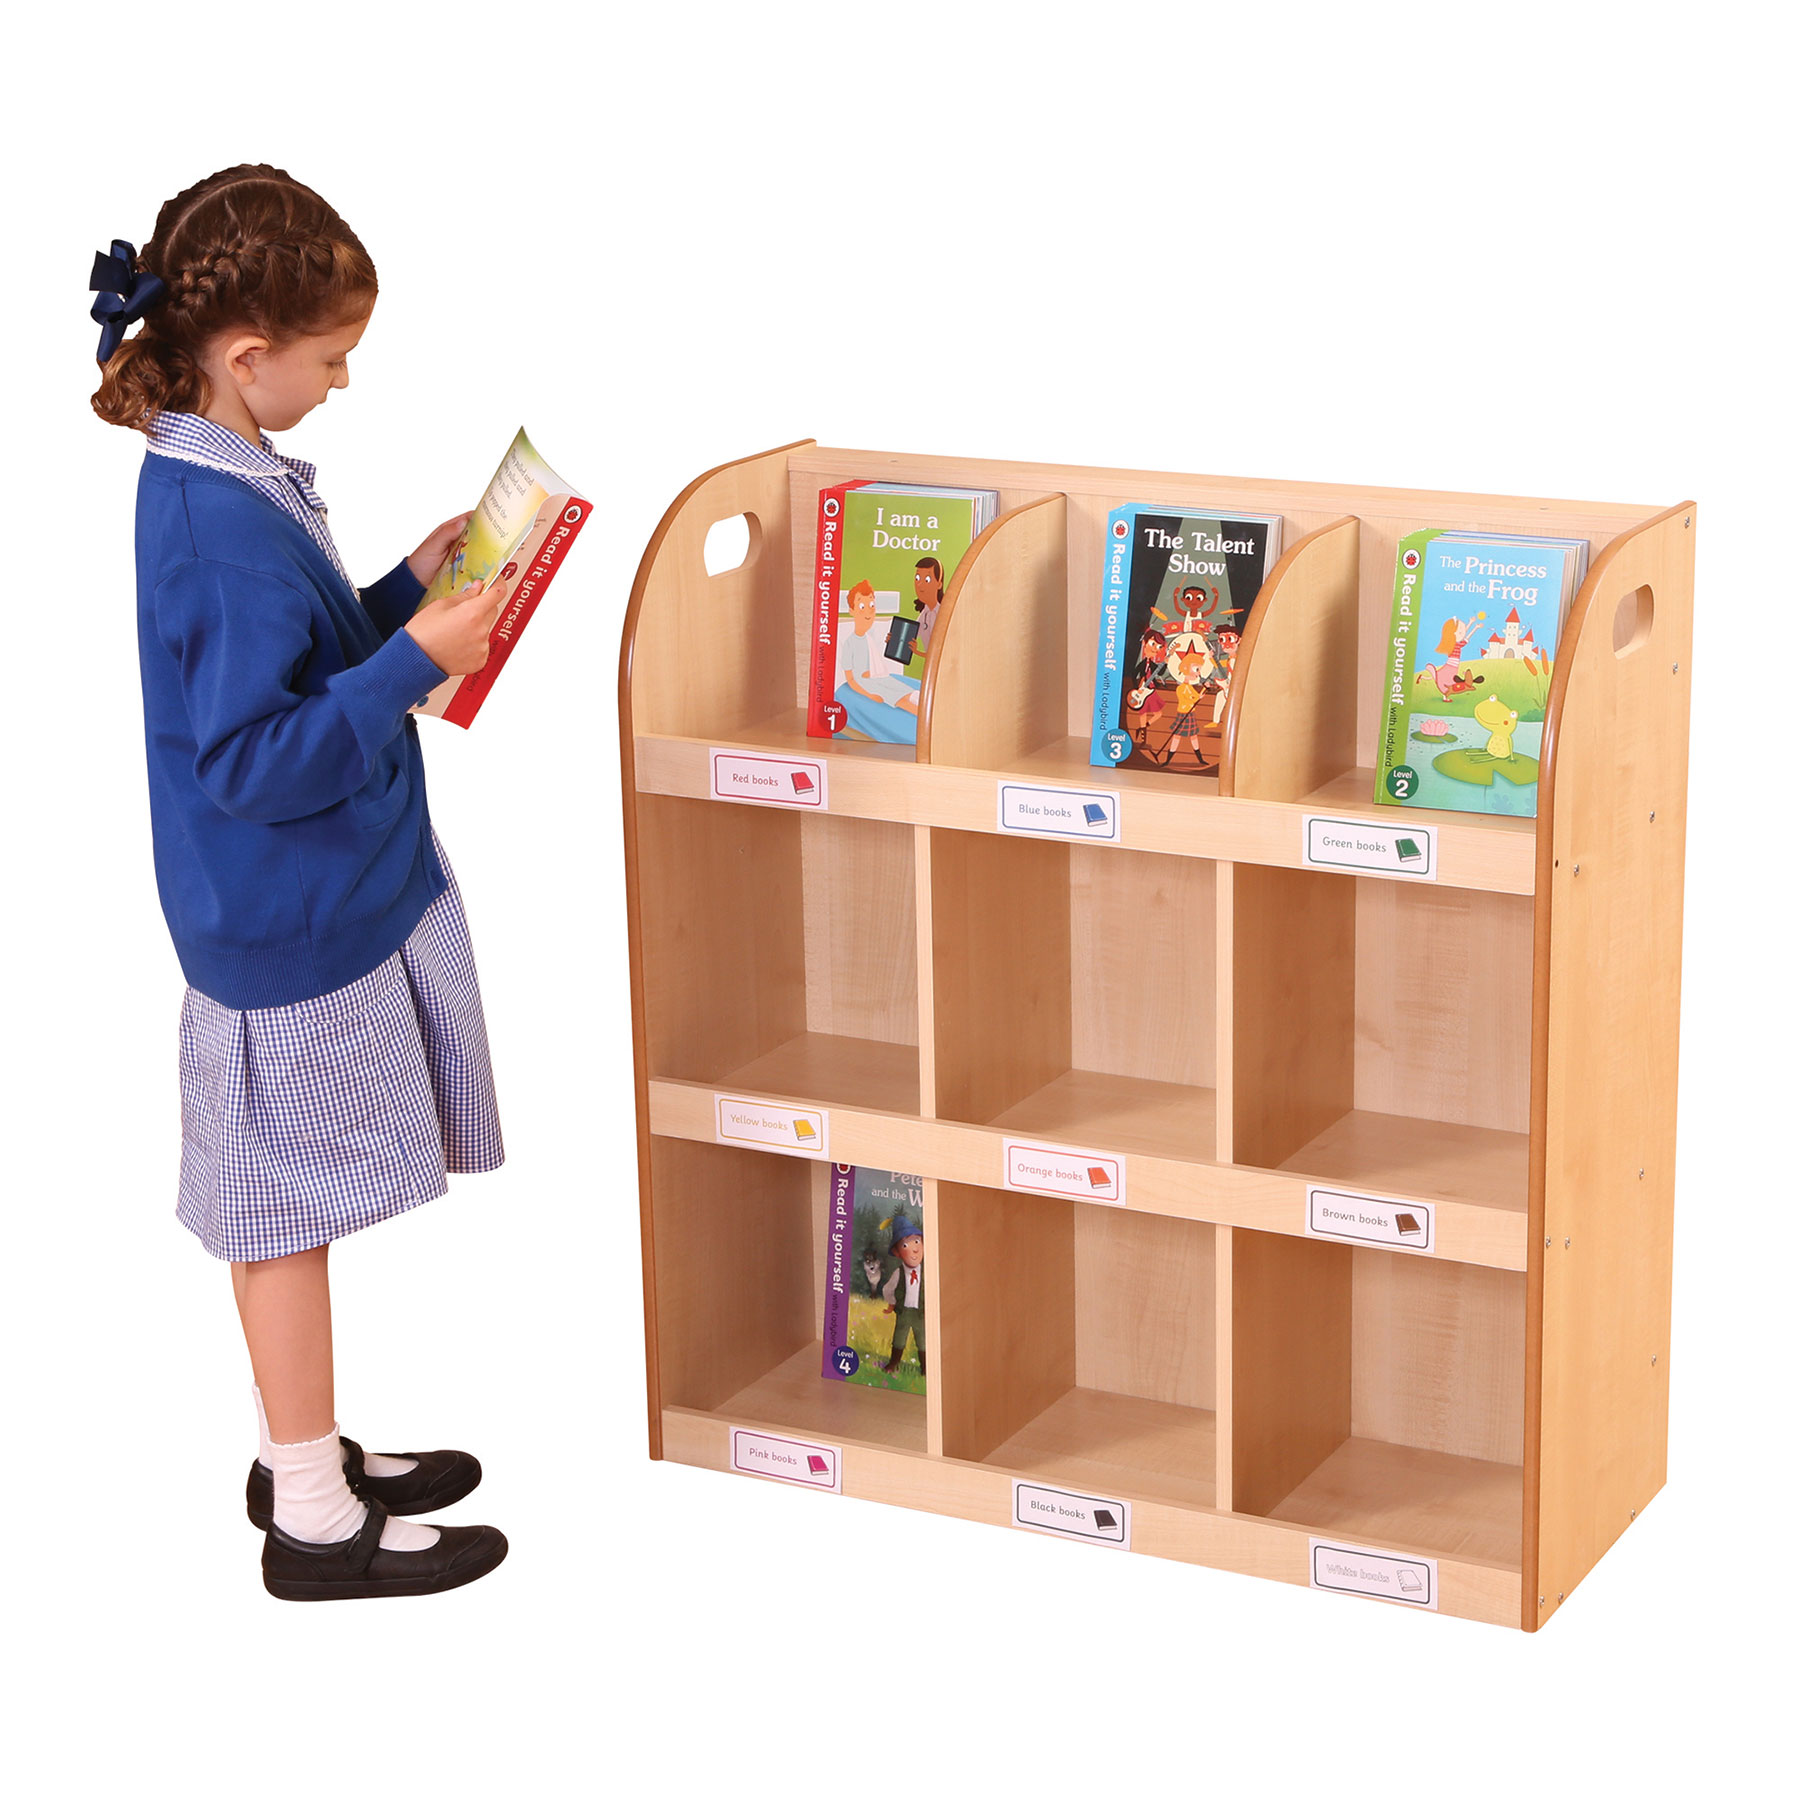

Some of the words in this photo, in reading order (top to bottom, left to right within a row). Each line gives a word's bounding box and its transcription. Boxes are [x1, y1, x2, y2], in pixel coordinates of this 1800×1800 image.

[876, 508, 884, 526] I
[890, 514, 920, 528] am
[927, 516, 939, 529] a
[541, 526, 570, 564] Read
[823, 521, 837, 561] Read
[872, 529, 941, 551] Doctor
[1144, 528, 1184, 549] The
[1191, 532, 1255, 555] Talent
[532, 566, 547, 579] it
[822, 565, 835, 577] it
[1110, 544, 1126, 584] Read
[1168, 554, 1226, 576] Show
[1440, 556, 1462, 568] The
[1464, 556, 1547, 579] Princess
[1109, 589, 1122, 601] it
[1400, 574, 1416, 616] Read
[1443, 581, 1465, 592] and
[1468, 582, 1486, 593] the
[1487, 579, 1538, 606] Frog
[498, 580, 536, 641] yourself
[819, 581, 831, 645] yourself
[1398, 621, 1412, 633] it
[1104, 605, 1118, 671] yourself
[1392, 637, 1407, 706] yourself
[824, 705, 842, 713] Level
[1099, 692, 1109, 730] Ladybird
[827, 714, 836, 731] 1
[1107, 733, 1126, 741] Level
[1110, 742, 1122, 760] 3
[1385, 728, 1396, 767] Ladybird
[732, 773, 749, 783] Red
[752, 775, 778, 786] books
[1393, 770, 1413, 779] Level
[1395, 779, 1409, 797] 2
[1018, 804, 1040, 814] Blue
[1043, 806, 1072, 818] books
[1322, 836, 1352, 848] Green
[1356, 840, 1387, 852] books
[730, 1114, 759, 1126] Yellow
[762, 1118, 788, 1130] books
[1017, 1163, 1052, 1178] Orange
[1056, 1168, 1083, 1181] books
[836, 1178, 849, 1216] Read
[871, 1188, 889, 1198] and
[892, 1189, 906, 1200] the
[835, 1219, 847, 1230] it
[1322, 1208, 1355, 1222] Brown
[1359, 1213, 1388, 1227] books
[832, 1234, 844, 1294] yourself
[831, 1294, 839, 1310] with
[829, 1312, 838, 1347] Ladybird
[837, 1350, 853, 1358] Level
[839, 1358, 851, 1374] 4
[749, 1448, 769, 1459] Pink
[772, 1452, 797, 1465] books
[1030, 1500, 1056, 1513] Black
[1059, 1506, 1086, 1519] books
[1326, 1563, 1358, 1577] White
[1360, 1569, 1390, 1583] books
